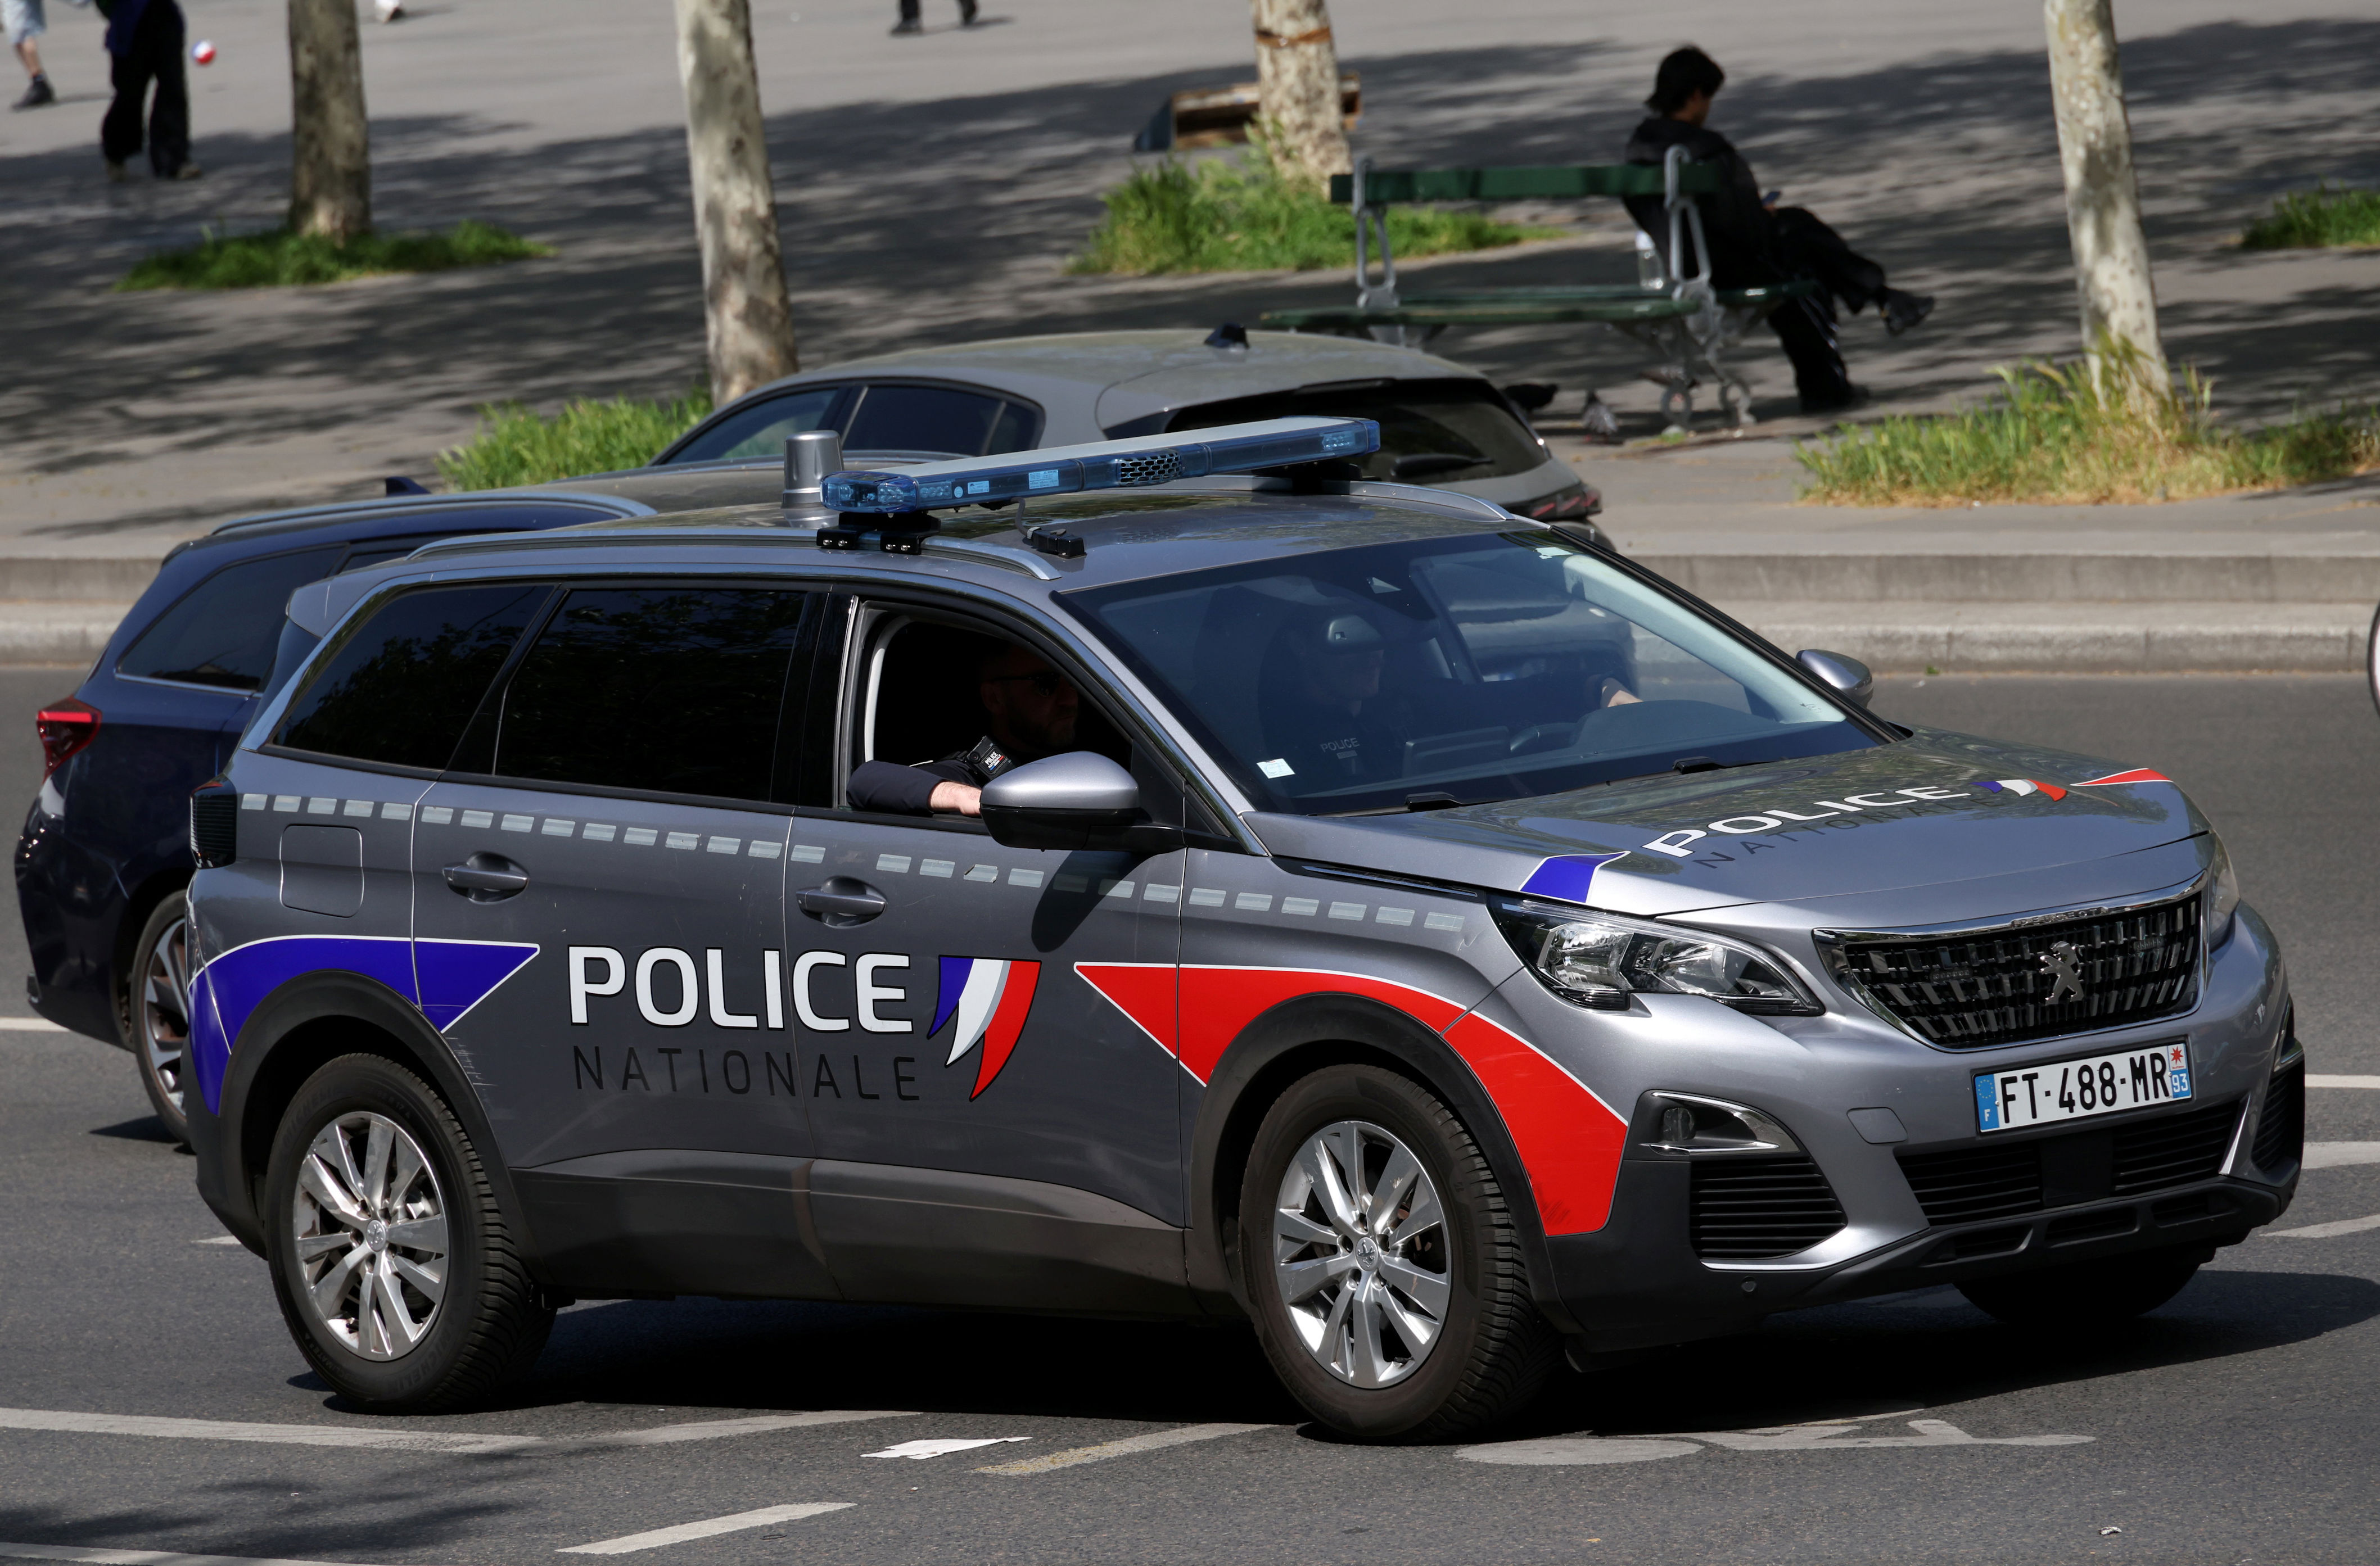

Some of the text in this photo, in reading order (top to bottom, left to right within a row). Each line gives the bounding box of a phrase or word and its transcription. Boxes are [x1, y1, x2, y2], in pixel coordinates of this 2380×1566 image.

[984, 751, 998, 765] POLICE
[1320, 737, 1360, 753] POLICE
[1641, 786, 1971, 858] POLICE
[1692, 798, 2004, 869] NATIONALE
[568, 945, 913, 1034] POLICE
[573, 1045, 920, 1101] NATIONALE
[2000, 1052, 2169, 1124] FT-488-MR
[2171, 1073, 2188, 1093] 93
[1984, 1108, 1991, 1122] F
